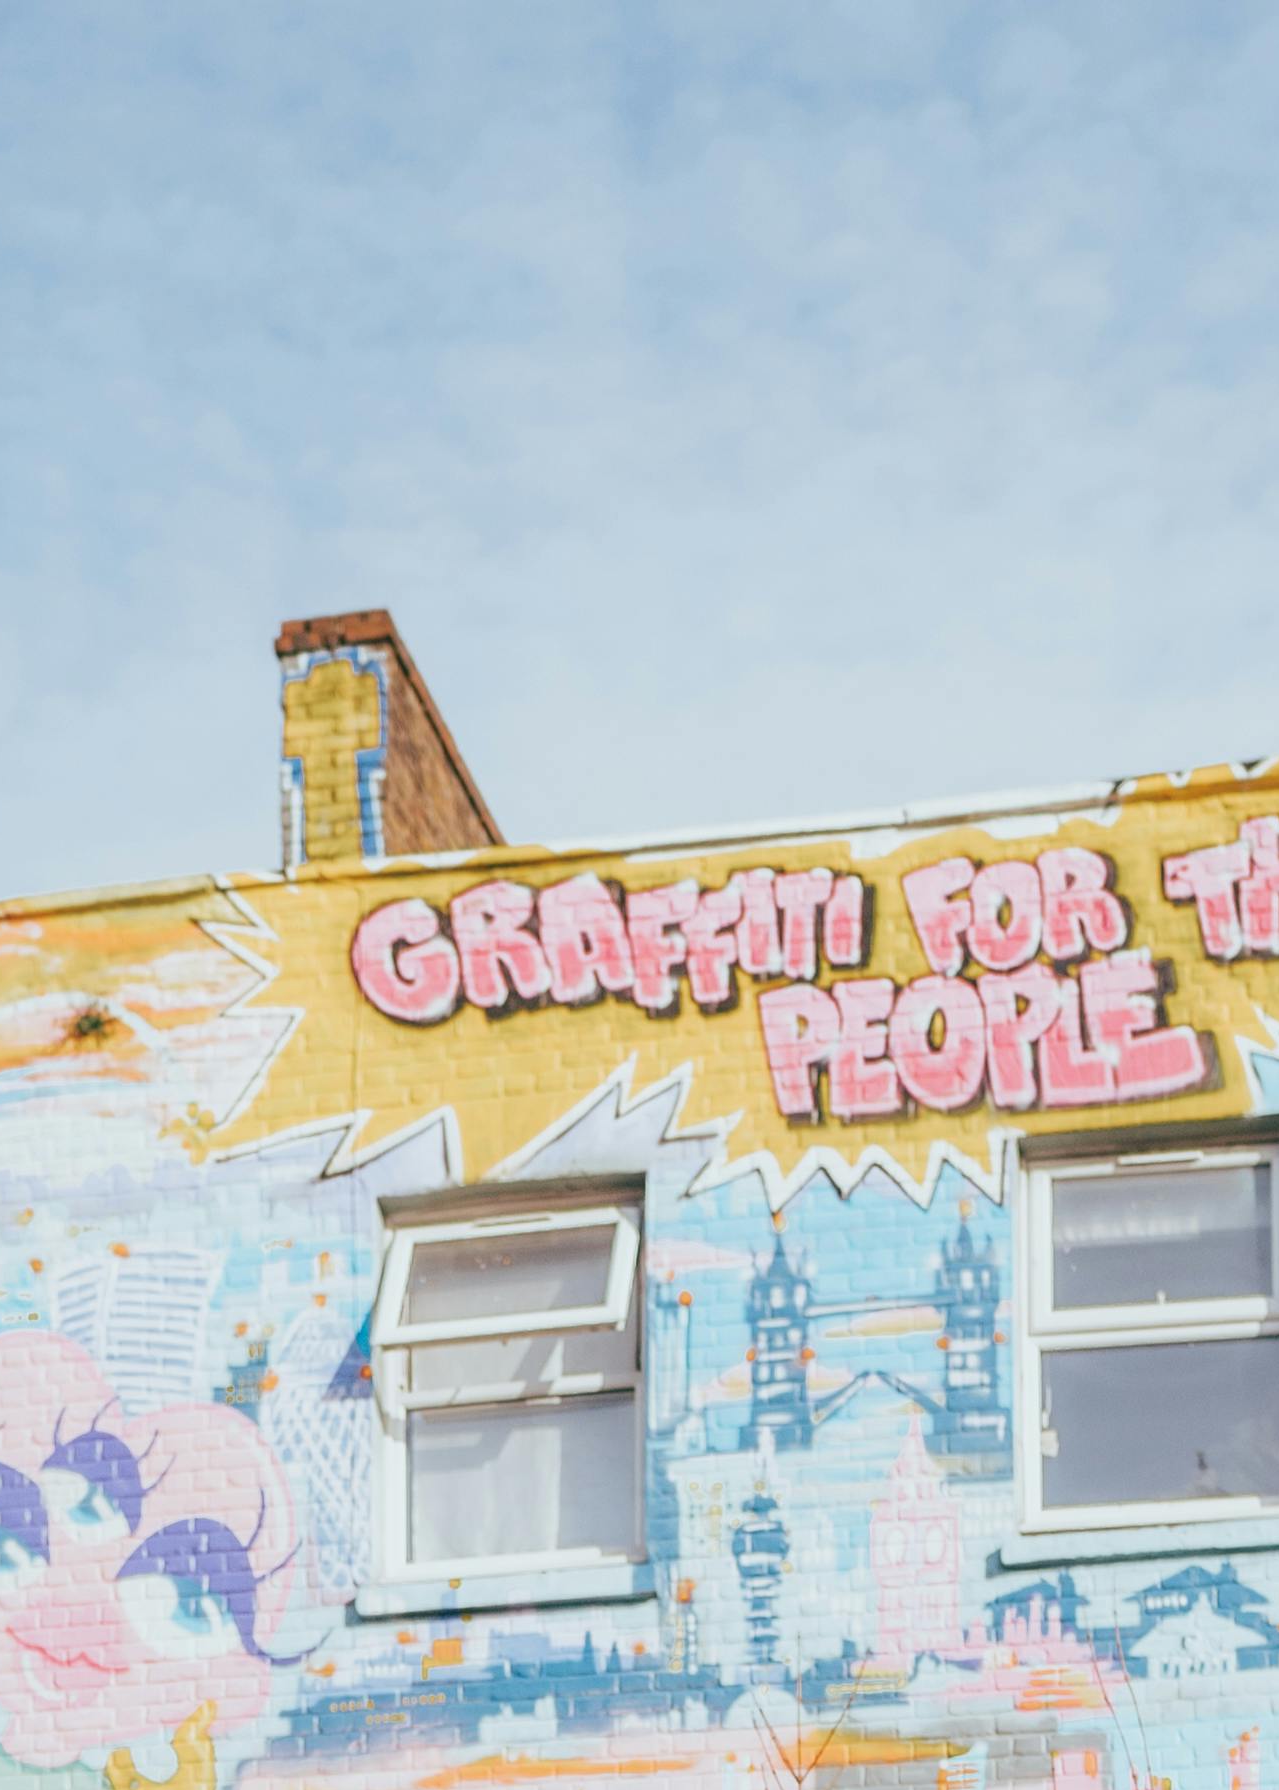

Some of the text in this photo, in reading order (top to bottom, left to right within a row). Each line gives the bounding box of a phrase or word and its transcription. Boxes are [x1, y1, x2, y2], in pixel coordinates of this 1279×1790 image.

[351, 866, 868, 1023] GRAFFITI
[902, 848, 1129, 972] FOR
[758, 950, 1214, 1121] PEOPLE
